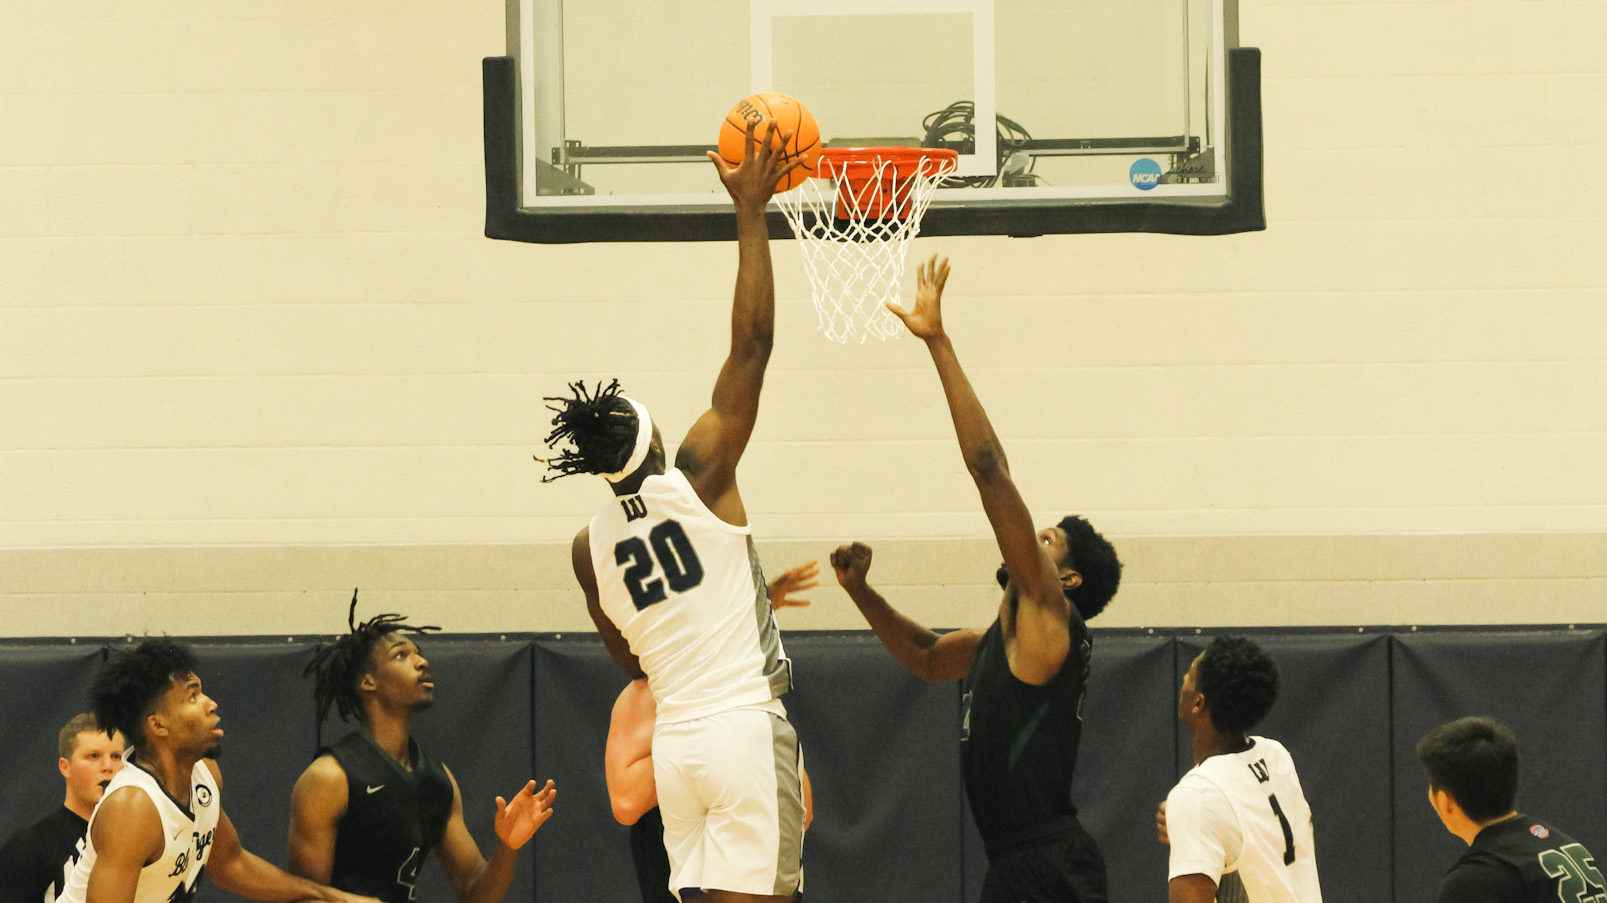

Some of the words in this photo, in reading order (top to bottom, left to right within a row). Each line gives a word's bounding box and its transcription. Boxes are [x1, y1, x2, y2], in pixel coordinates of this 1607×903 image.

[613, 518, 705, 612] 20
[1268, 792, 1296, 867] 1
[1538, 842, 1607, 903] 25
